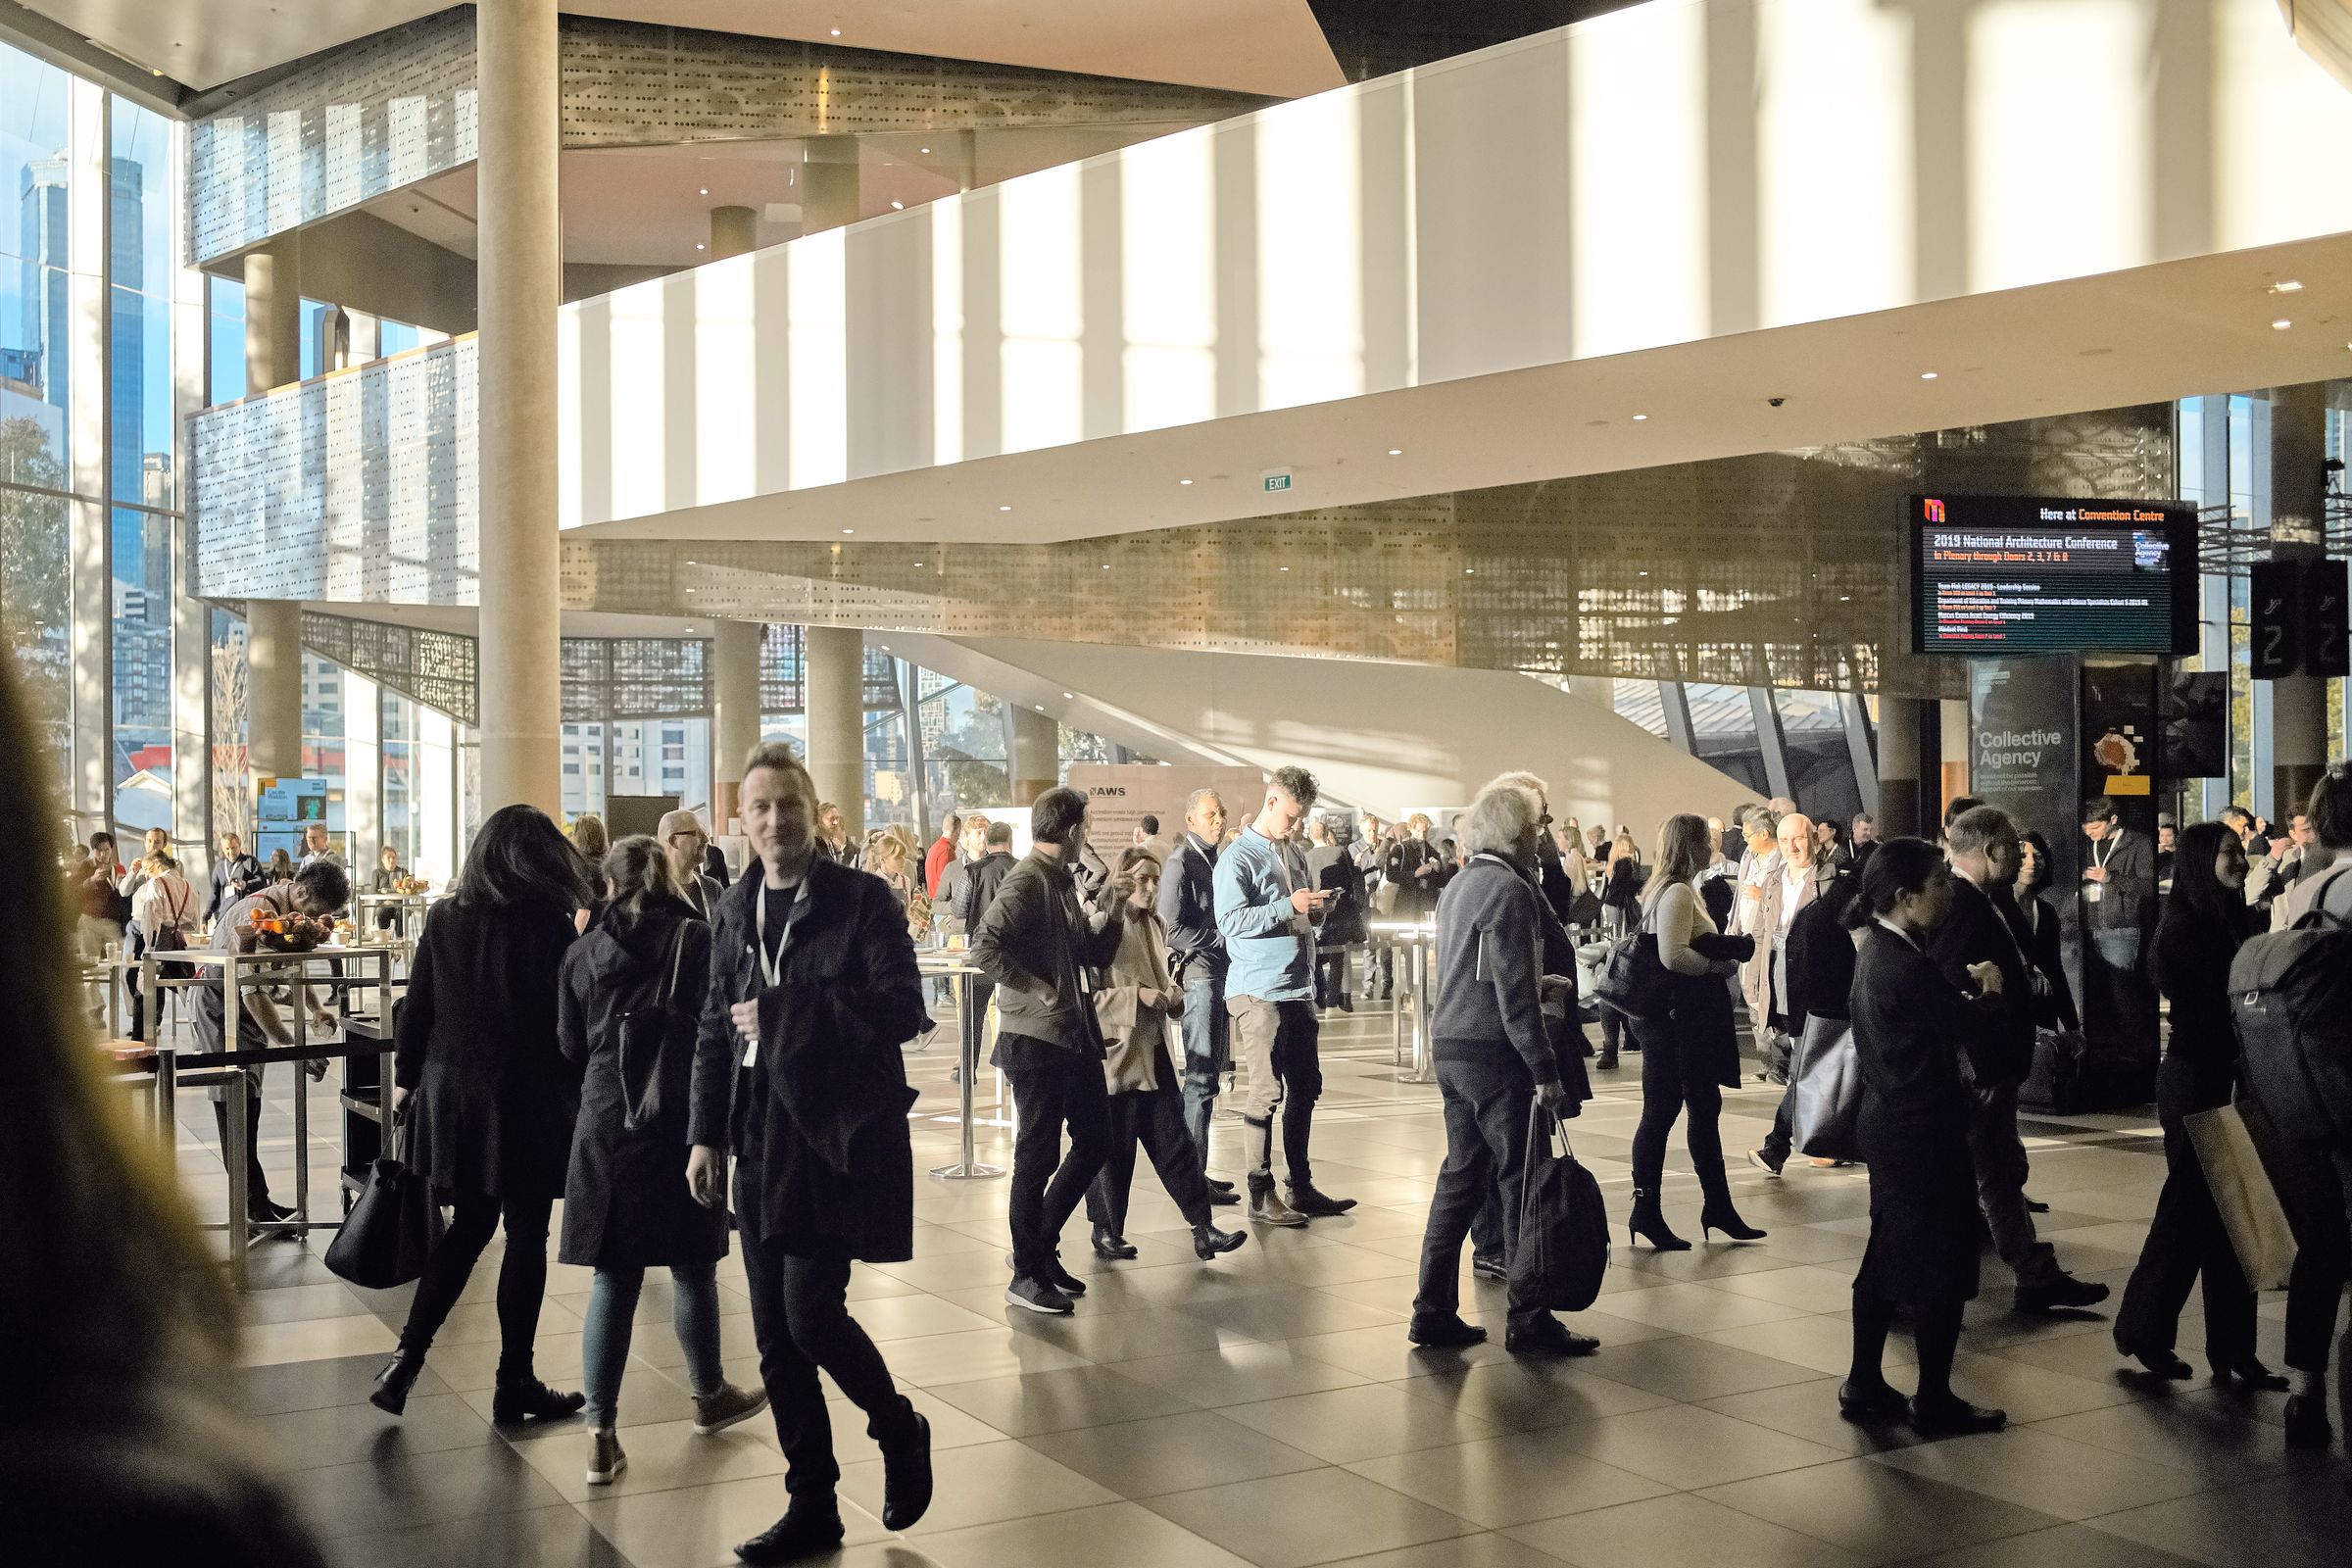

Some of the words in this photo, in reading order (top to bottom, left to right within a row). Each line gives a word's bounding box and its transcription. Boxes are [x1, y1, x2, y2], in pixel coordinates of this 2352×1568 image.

[1269, 477, 1287, 490] EXIT
[2040, 508, 2063, 520] Here
[2065, 509, 2077, 520] at
[2079, 509, 2131, 521] Convention
[2133, 510, 2164, 521] Centre
[1934, 534, 1960, 547] 2019
[1963, 535, 2003, 548] National
[2005, 535, 2063, 549] Architecture
[2065, 536, 2118, 549] Conference
[1934, 551, 1941, 560] In
[1943, 550, 1972, 563] Plenary
[1973, 551, 2002, 563] through
[2004, 552, 2026, 562] Doors
[2028, 552, 2035, 563] 2,
[2036, 552, 2045, 563] 3,
[2046, 552, 2052, 562] 7
[2263, 624, 2282, 665] 2
[1980, 729, 2061, 748] Collective
[1980, 750, 2041, 769] Agency
[1098, 787, 1126, 797] AWS
